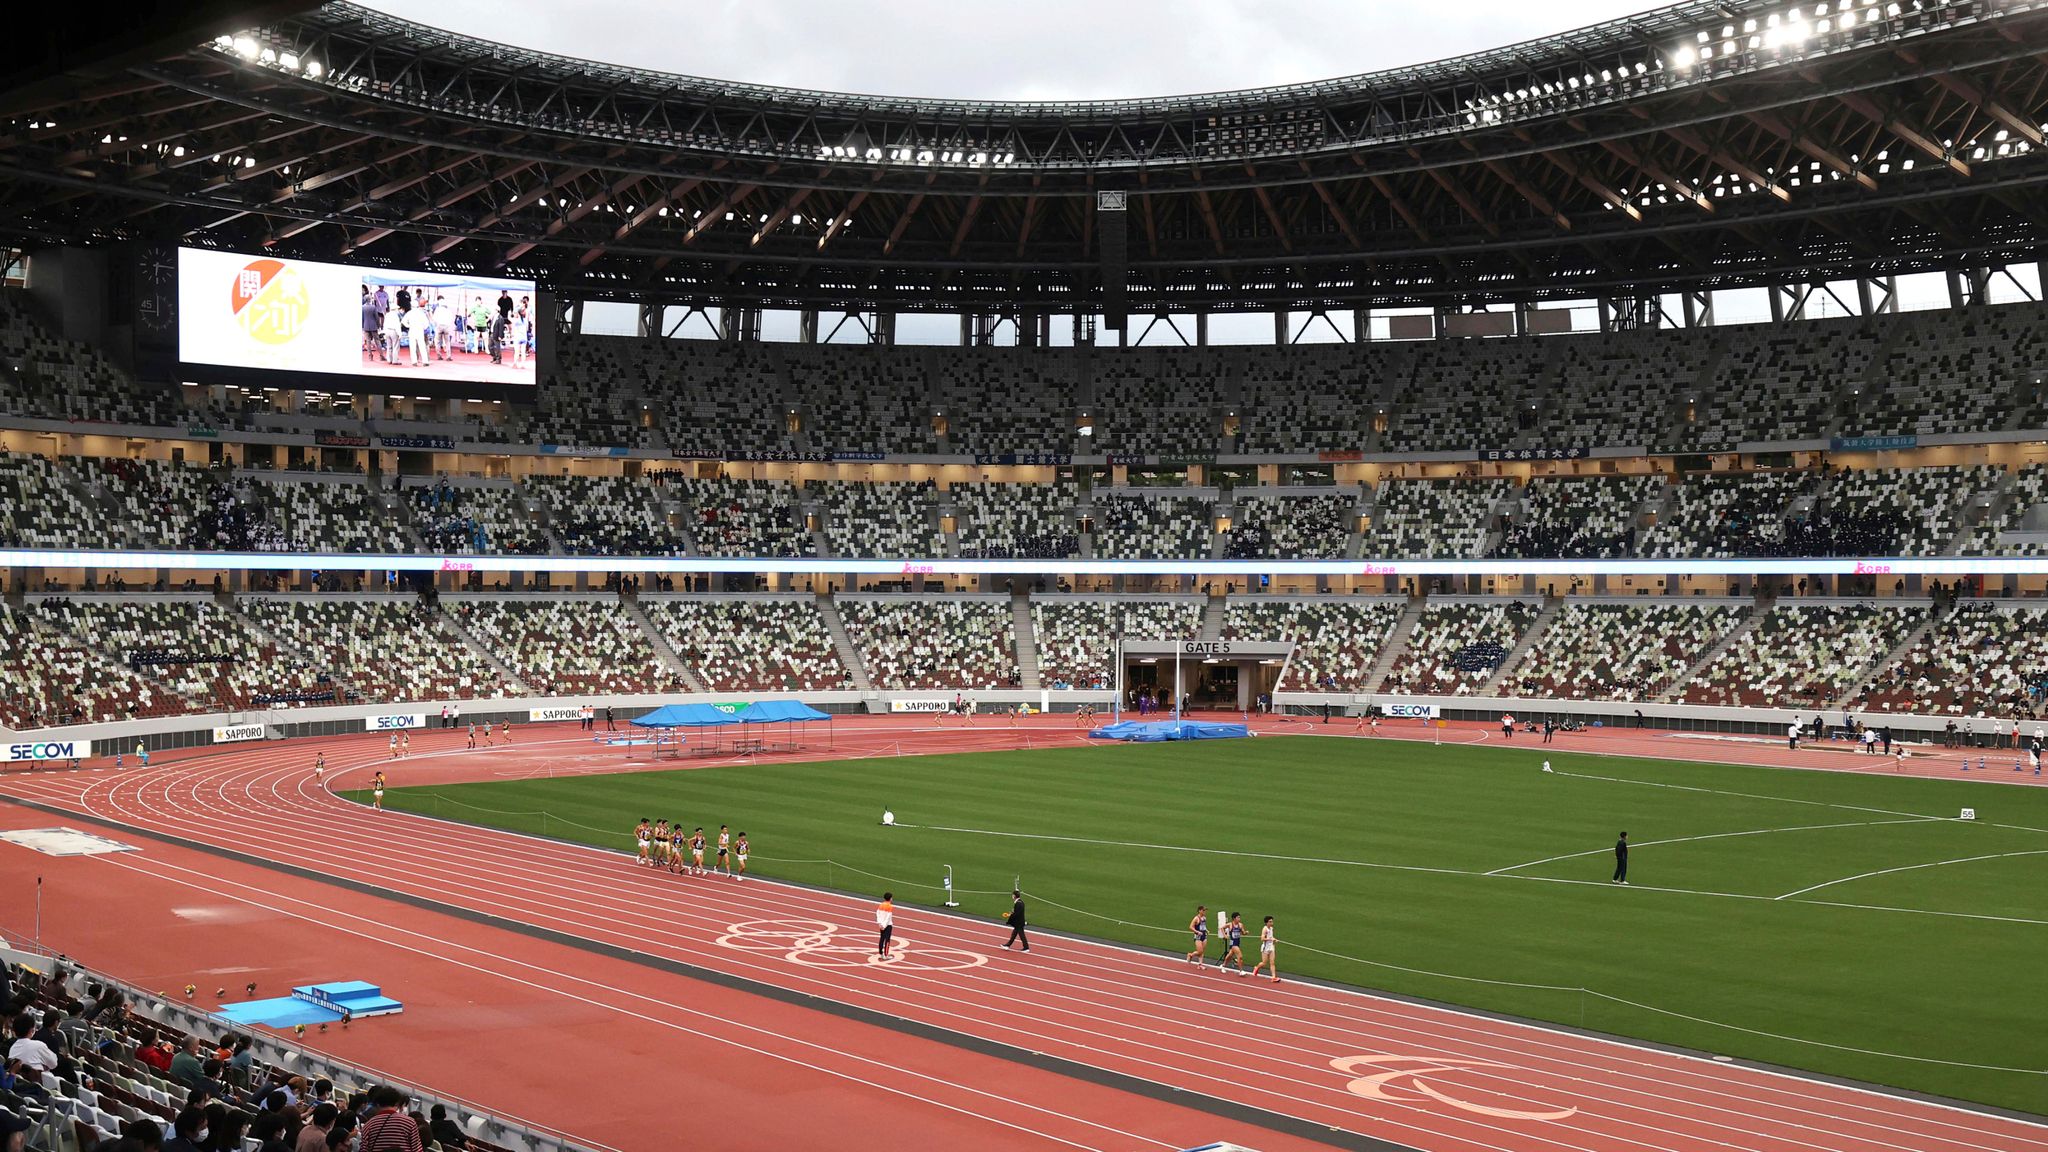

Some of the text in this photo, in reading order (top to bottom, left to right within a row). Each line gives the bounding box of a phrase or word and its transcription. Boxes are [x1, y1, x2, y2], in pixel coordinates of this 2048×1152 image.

[382, 438, 424, 447] ただひとつ
[745, 451, 827, 461] 東京女子体育大学
[1488, 448, 1580, 459] 日本体育大学
[443, 559, 473, 571] KCRR
[904, 562, 934, 574] KCRR
[1365, 563, 1396, 575] KCRR
[1856, 561, 1890, 575] KCRR
[1185, 642, 1230, 653] GATE 5
[905, 702, 946, 711] SAPPORO
[1391, 705, 1431, 716] SECOM
[377, 715, 415, 728] SECOM
[225, 727, 262, 740] SAPPORO
[10, 743, 74, 760] SECOM
[1962, 810, 1974, 818] 55
